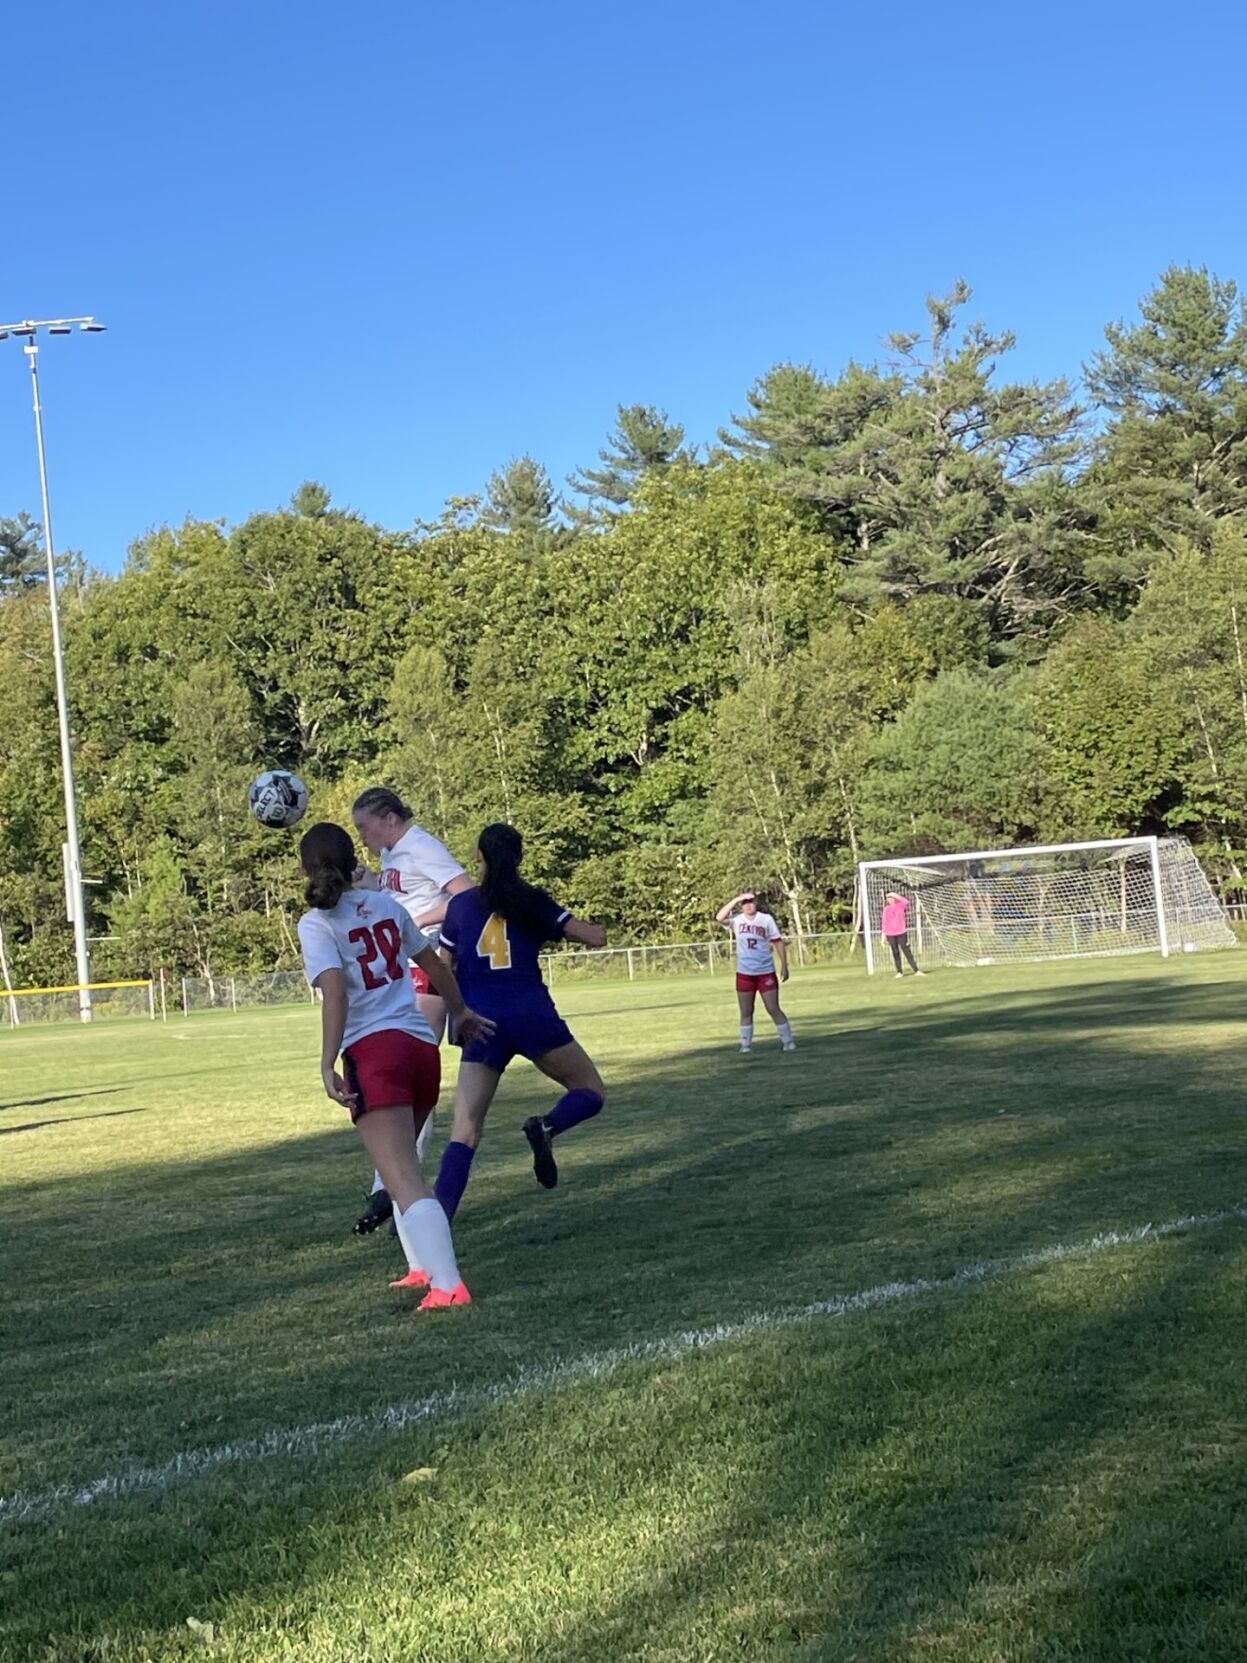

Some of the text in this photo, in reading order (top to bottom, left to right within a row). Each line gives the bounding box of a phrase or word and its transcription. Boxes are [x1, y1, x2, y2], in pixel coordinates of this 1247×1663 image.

[348, 918, 404, 991] 20
[475, 911, 512, 970] 4
[747, 938, 758, 950] 12
